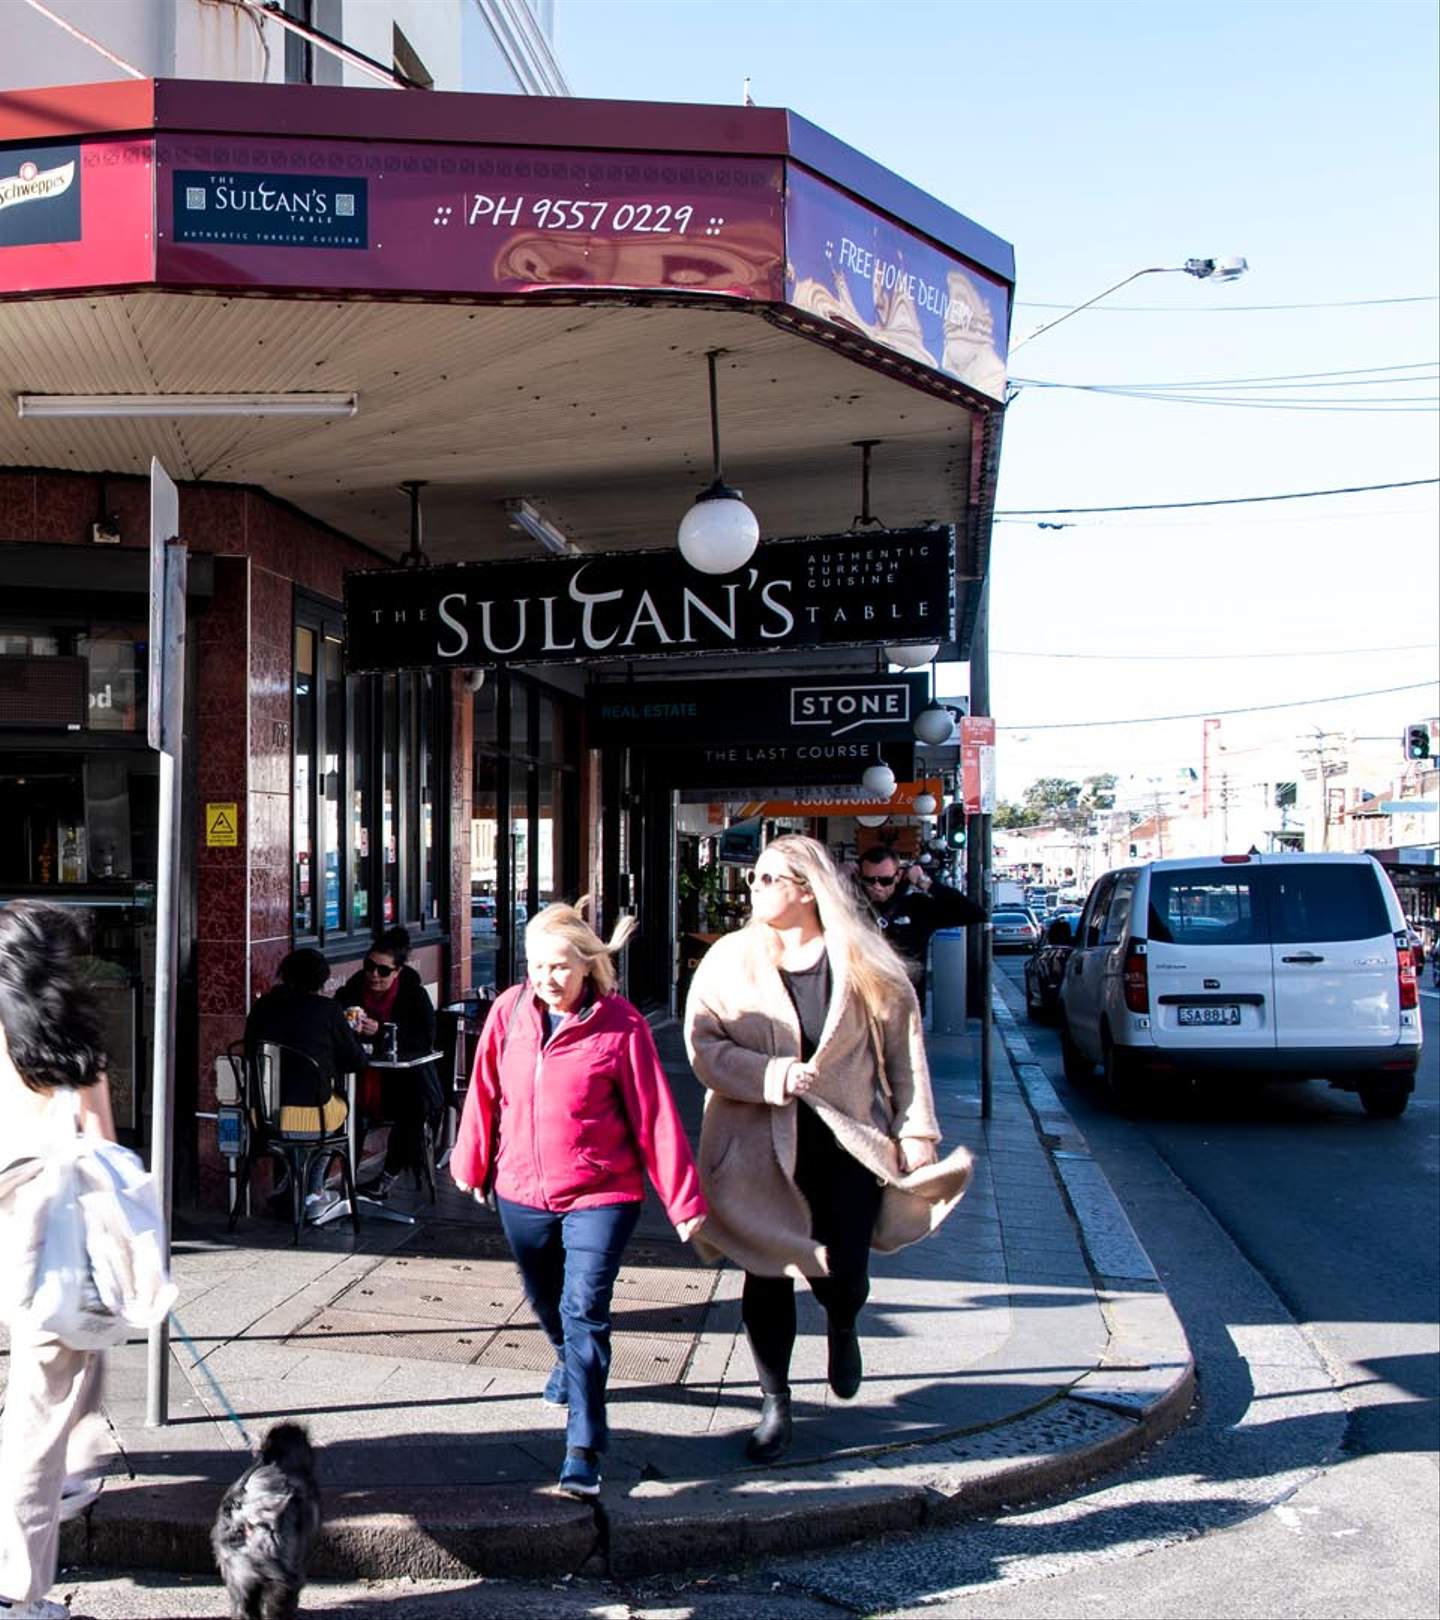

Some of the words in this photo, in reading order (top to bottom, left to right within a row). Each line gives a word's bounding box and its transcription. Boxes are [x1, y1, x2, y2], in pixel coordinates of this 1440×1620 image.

[210, 176, 234, 184] THE
[215, 181, 327, 213] SULTAN'S
[468, 194, 524, 226] PH
[531, 199, 608, 231] 9557
[612, 205, 693, 234] 0229
[838, 238, 872, 279] FREE
[873, 258, 915, 300] HOME
[808, 546, 929, 564] AUTHENTIC
[808, 561, 898, 576] TURKISH
[808, 573, 895, 588] CUISINE
[371, 607, 427, 625] THE
[437, 561, 794, 658] SULTAN'S
[805, 602, 929, 623] TABLE
[601, 704, 639, 719] REAL
[644, 703, 697, 717] ESTATE
[802, 694, 899, 715] STONE
[706, 750, 738, 762] THE
[746, 747, 788, 761] LAST
[796, 744, 870, 759] COURSE
[1187, 1008, 1238, 1021] SA88LA
